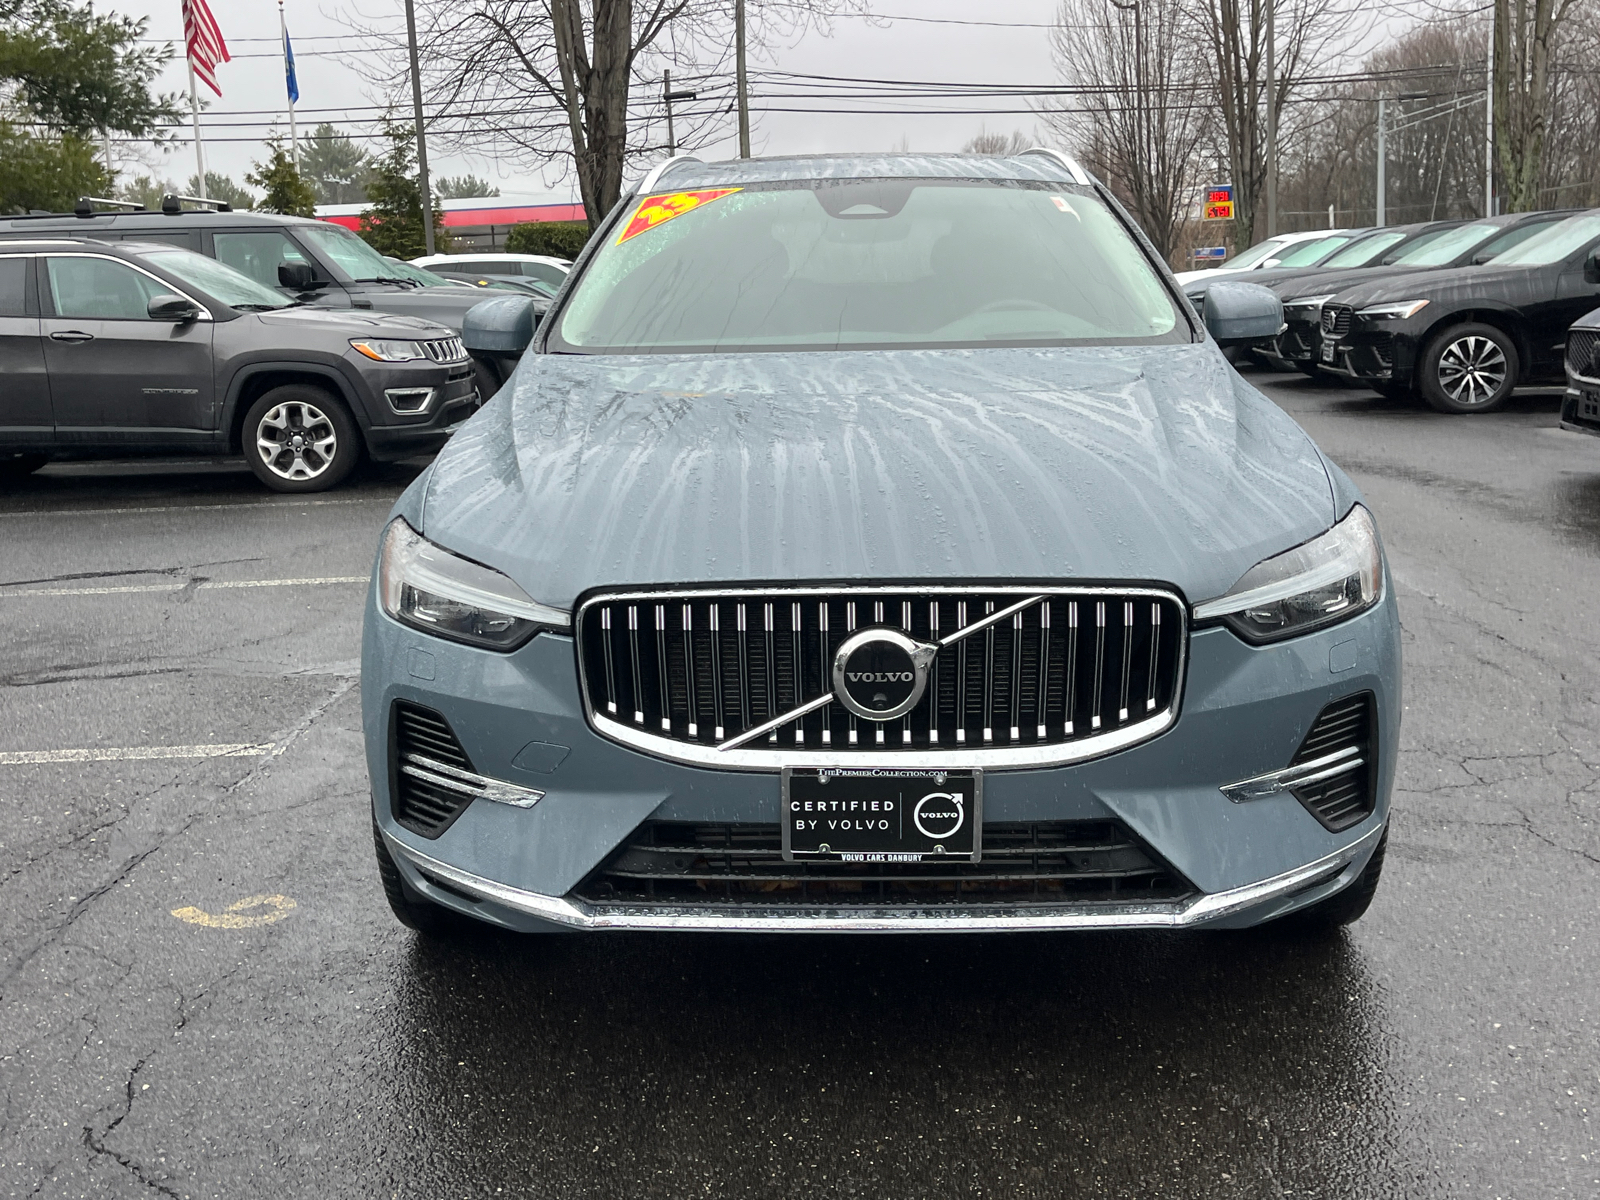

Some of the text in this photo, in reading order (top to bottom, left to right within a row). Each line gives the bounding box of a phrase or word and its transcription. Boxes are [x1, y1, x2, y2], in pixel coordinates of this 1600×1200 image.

[637, 193, 700, 225] 23
[846, 671, 914, 683] VOLVO
[790, 801, 895, 812] CERTIFIED
[919, 811, 959, 819] VOLVO
[796, 819, 889, 830] BY VOLVO
[841, 853, 923, 862] VOLVO CARS DANBURY
